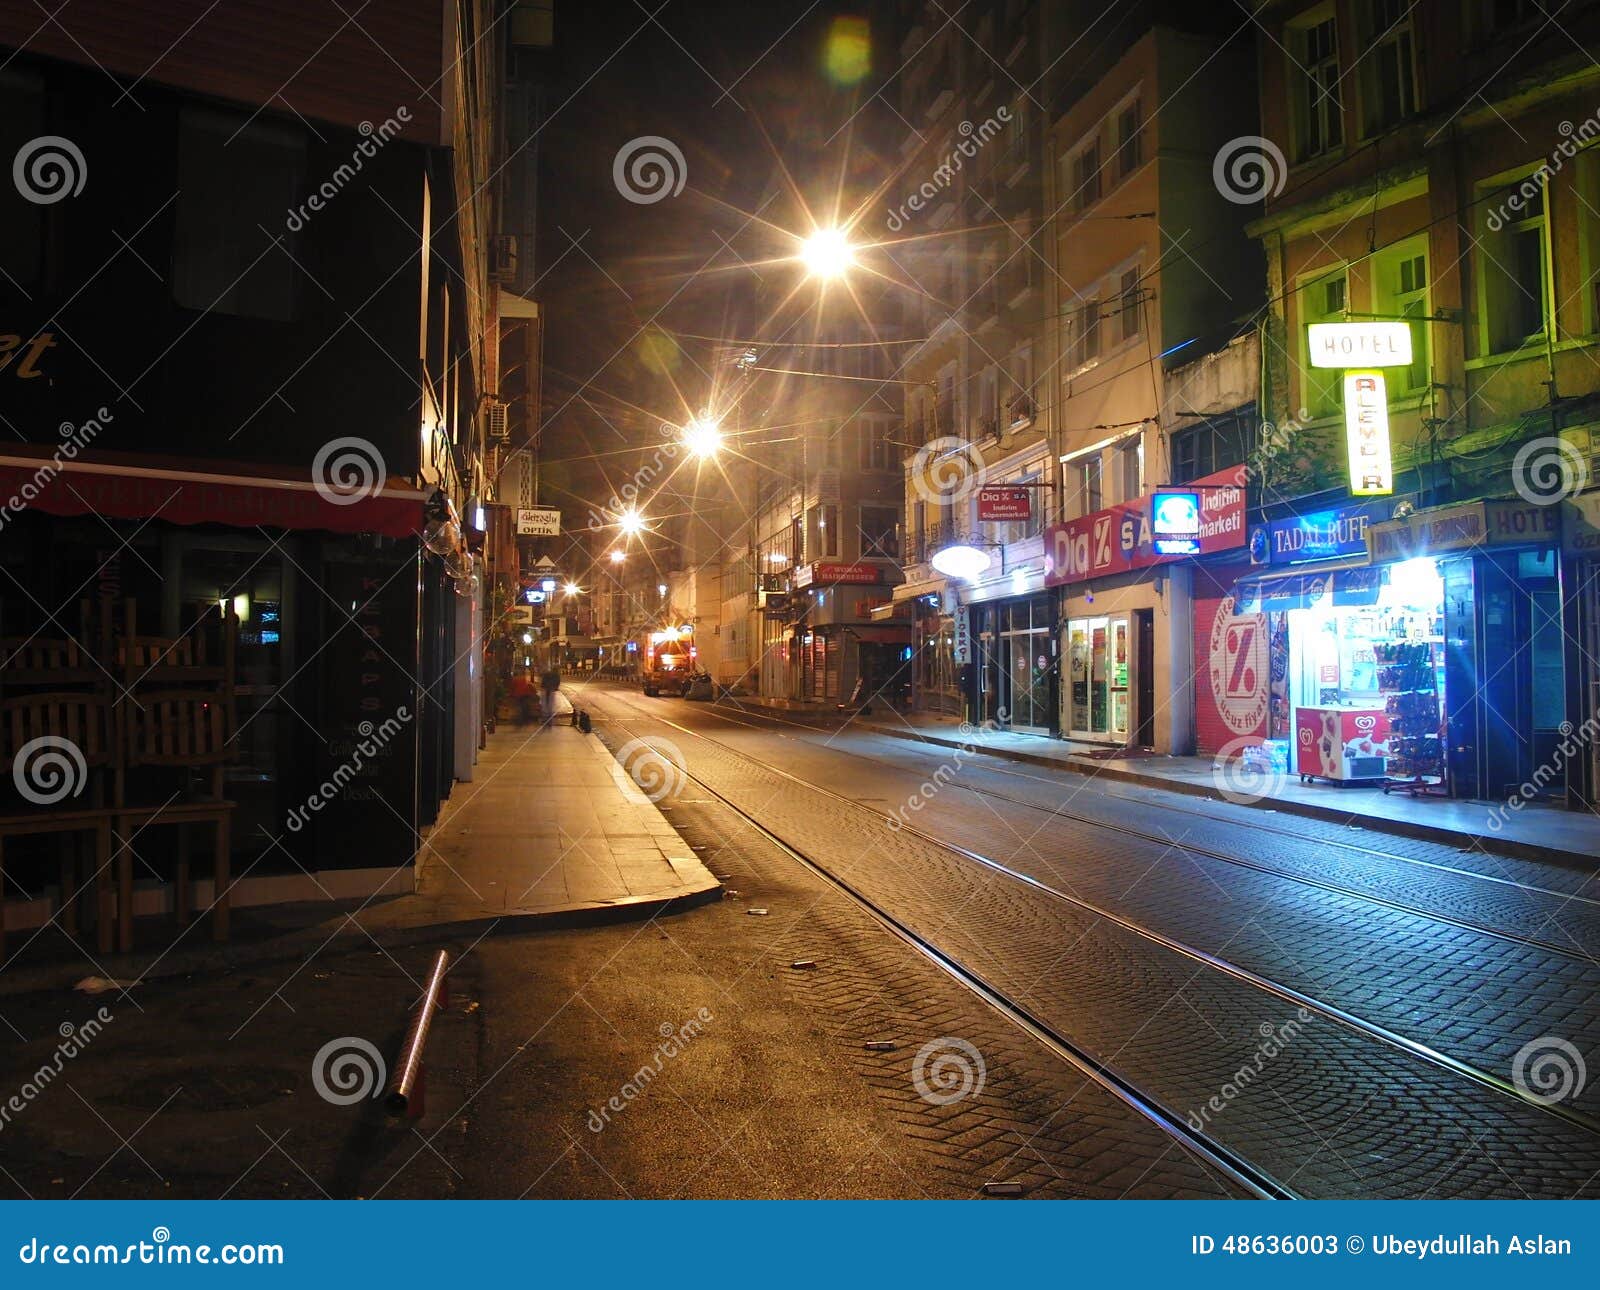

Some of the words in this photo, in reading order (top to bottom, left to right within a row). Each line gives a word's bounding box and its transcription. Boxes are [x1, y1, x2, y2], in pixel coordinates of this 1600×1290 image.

[1324, 335, 1398, 355] HOTEL
[1355, 378, 1384, 489] ALEMDR
[982, 492, 1000, 502] Dia
[1202, 488, 1241, 512] İndirim
[523, 527, 553, 535] OPTİK
[1274, 524, 1319, 553] TADAL
[1054, 527, 1090, 578] Dia
[1121, 515, 1153, 551] SA
